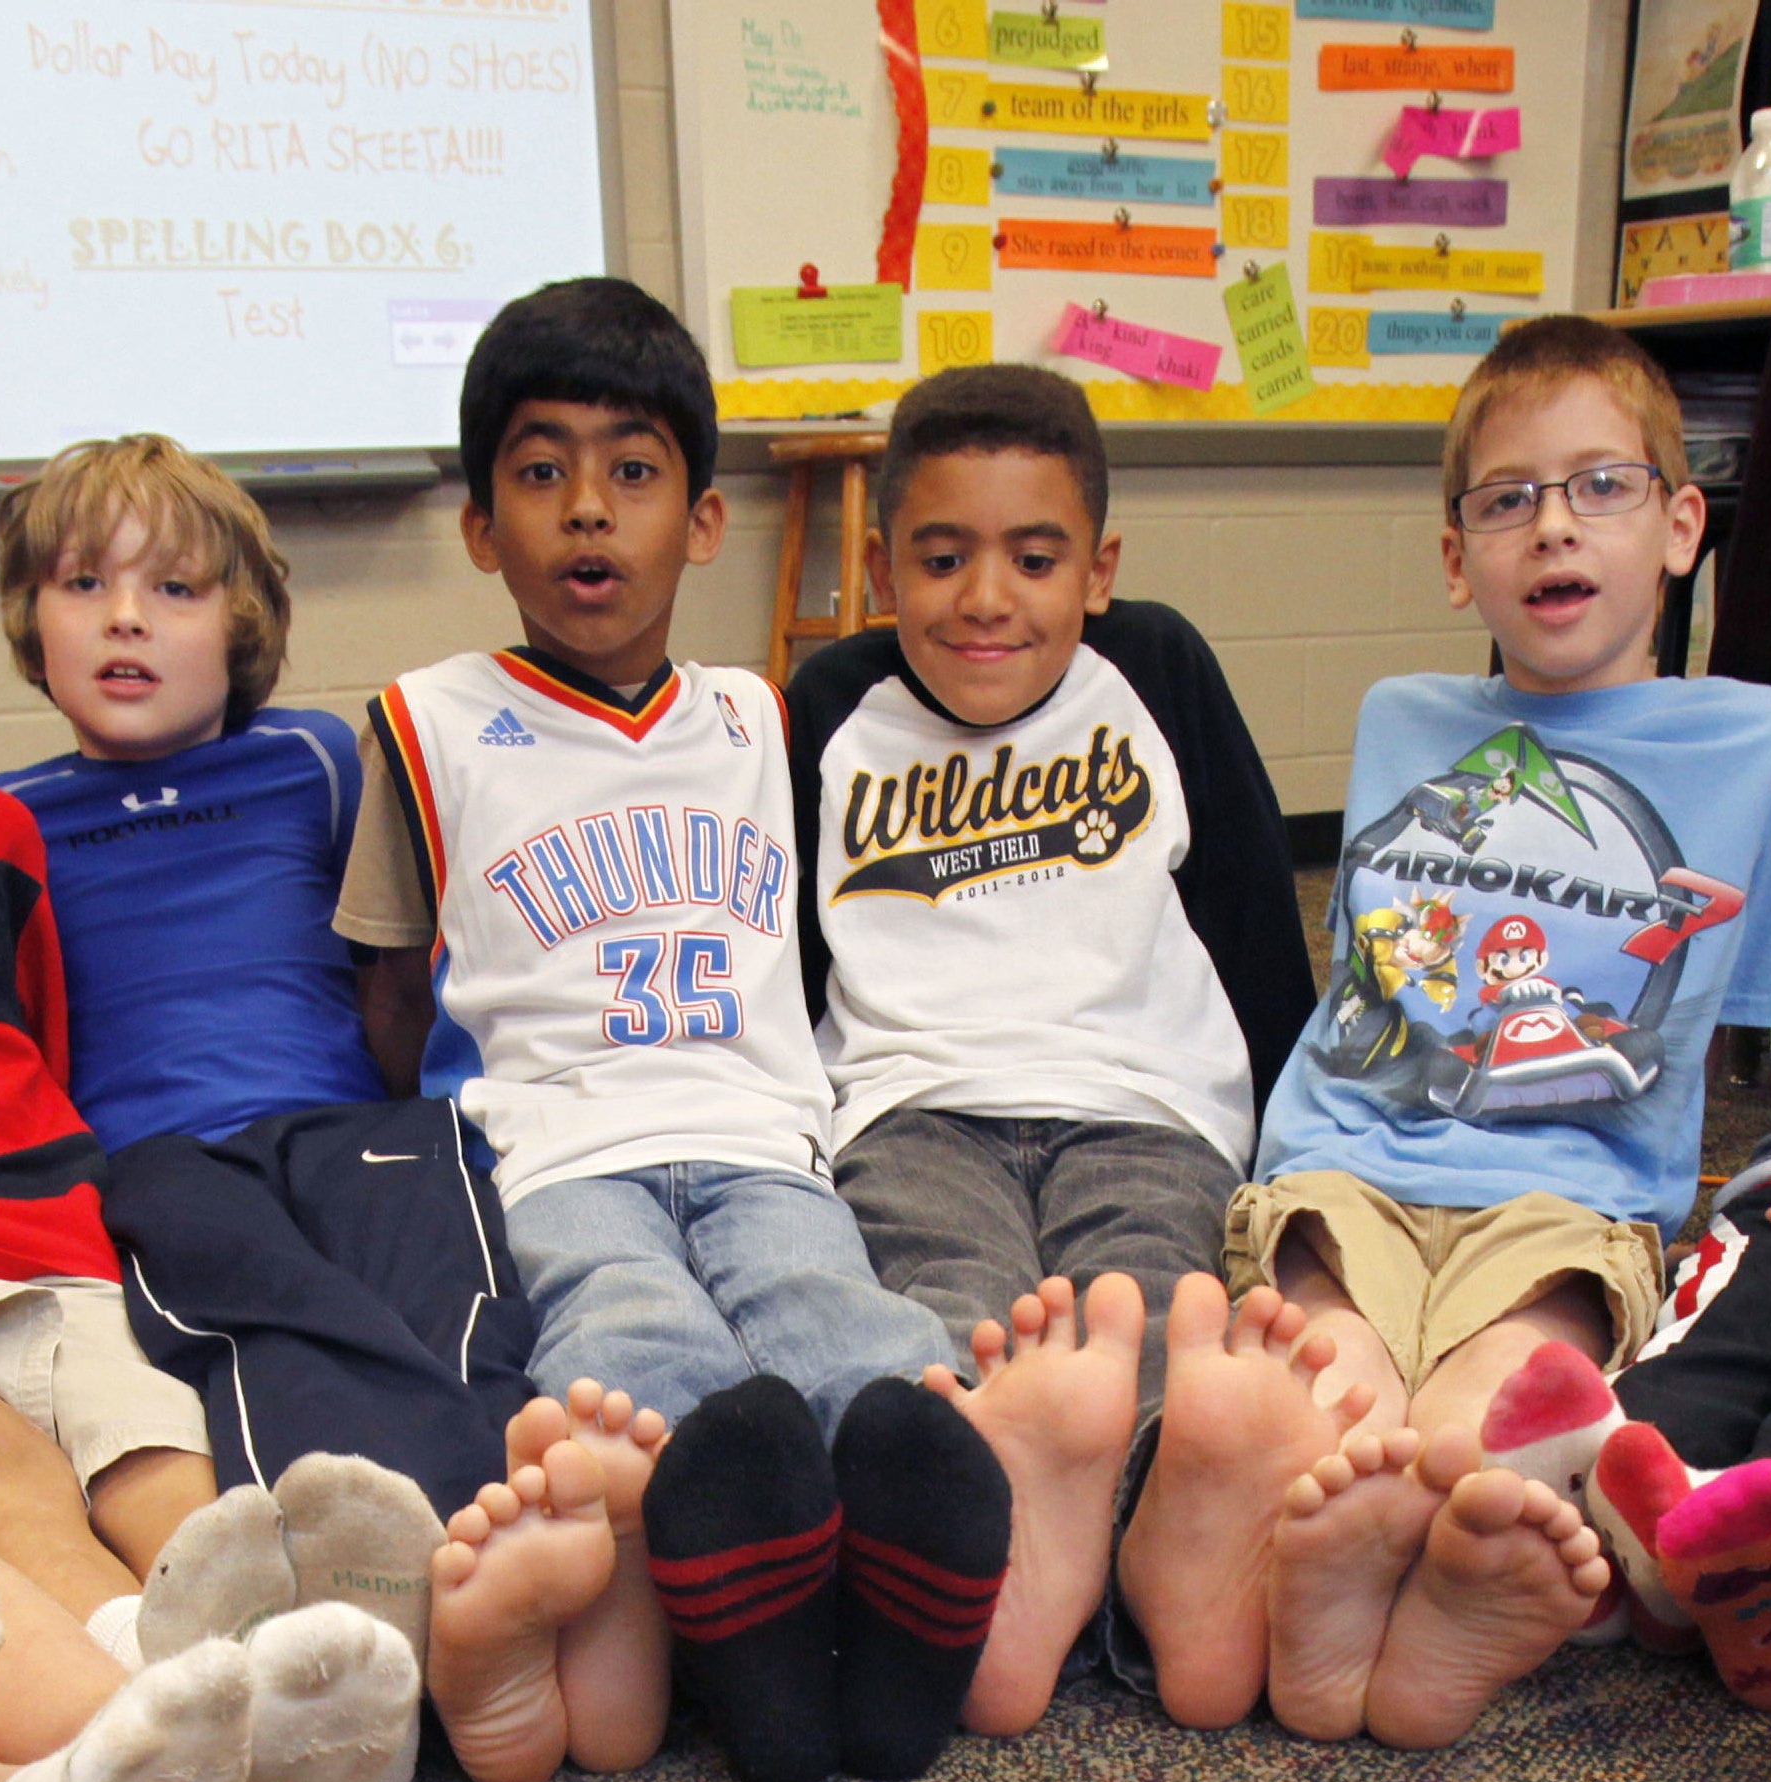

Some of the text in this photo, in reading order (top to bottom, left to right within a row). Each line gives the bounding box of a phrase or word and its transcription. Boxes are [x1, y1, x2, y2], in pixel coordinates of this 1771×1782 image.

[935, 8, 960, 48] 6
[996, 23, 1100, 57] prejudged
[1235, 6, 1281, 56] 15
[26, 20, 581, 110] Dollar Day Today (NO SHOES)
[938, 77, 965, 117] 7
[1011, 94, 1189, 128] team of the girls
[1234, 69, 1276, 116] 16
[138, 117, 193, 169] GO
[212, 118, 309, 173] RITA
[1235, 133, 1280, 180] 17
[937, 154, 963, 196] 8
[69, 218, 312, 267] SPELLING
[325, 220, 423, 267] BOX
[1233, 197, 1276, 244] 18
[941, 232, 968, 274] 9
[1011, 234, 1043, 256] She
[1099, 239, 1117, 257] to
[1119, 236, 1144, 259] the
[217, 288, 306, 340] Test
[1236, 302, 1294, 347] carried
[1313, 311, 1364, 356] 20
[1386, 320, 1492, 346] things you can
[929, 316, 979, 361] 10
[1251, 338, 1295, 373] cards
[1256, 365, 1304, 401] carrot
[842, 724, 1137, 862] Wildcats
[484, 806, 789, 950] THUNDER
[929, 835, 1041, 879] WEST FIELD
[597, 931, 744, 1047] 35
